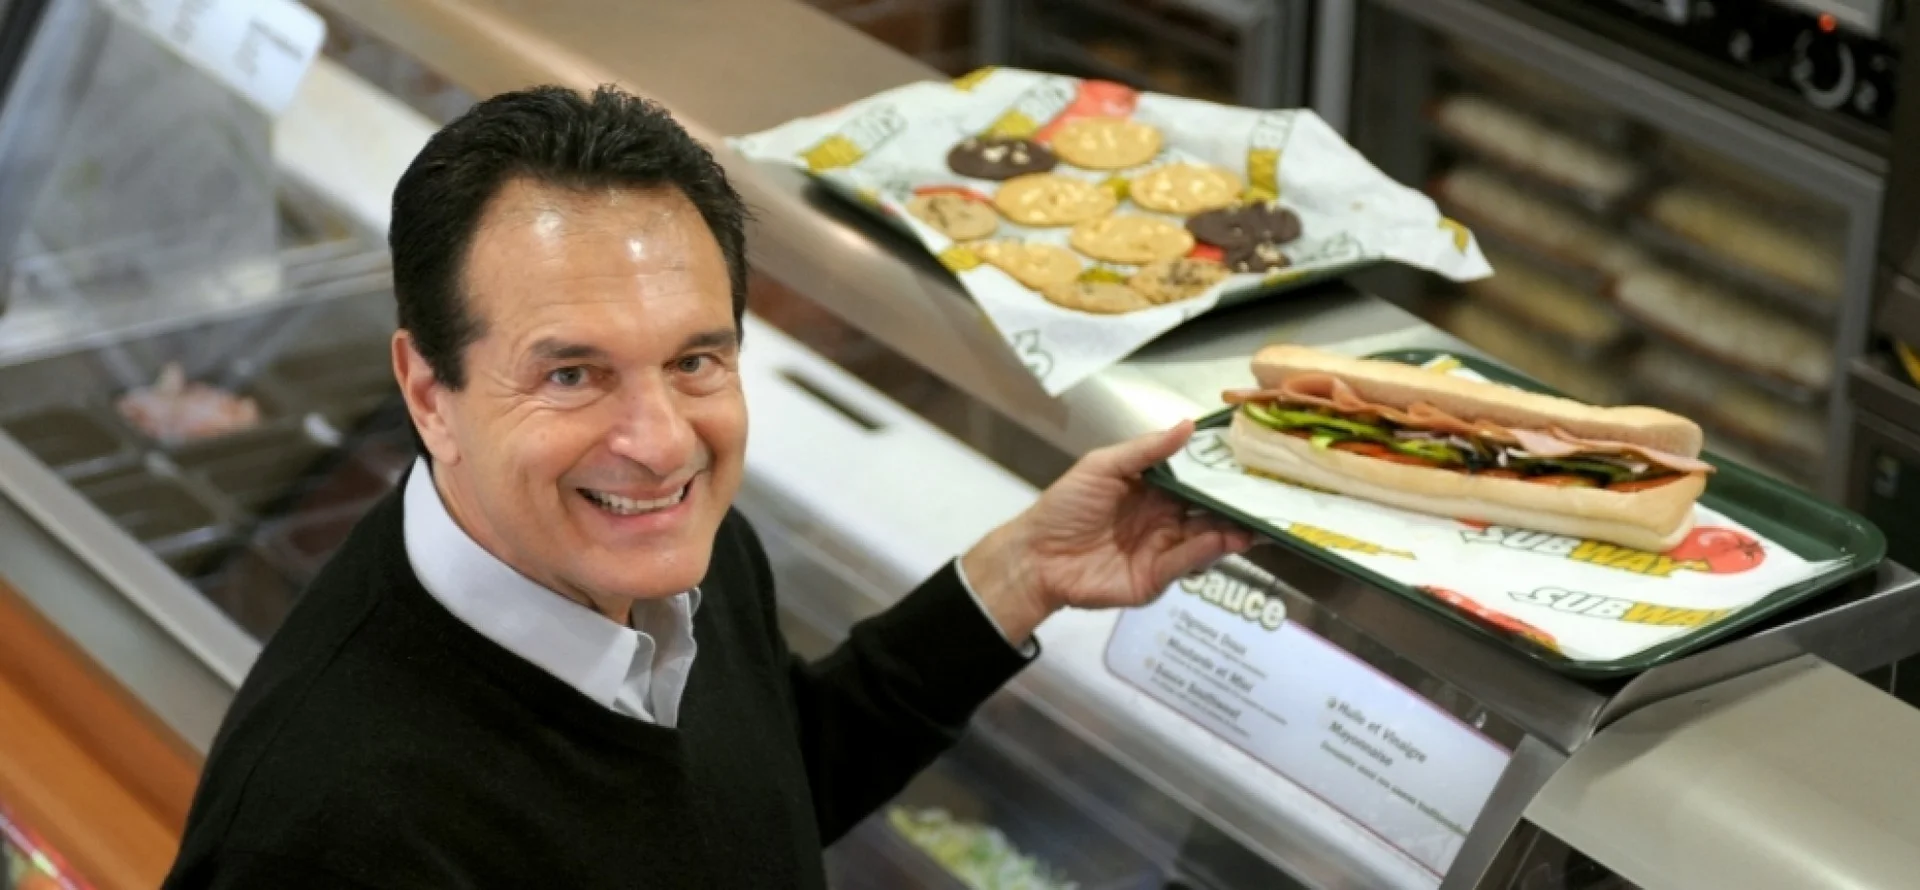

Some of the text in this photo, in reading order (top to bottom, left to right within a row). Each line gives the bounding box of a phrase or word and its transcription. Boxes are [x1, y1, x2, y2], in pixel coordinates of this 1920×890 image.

[1460, 524, 1712, 578] SUBWAY
[1328, 721, 1393, 766] Mayonnaise
[1367, 721, 1381, 734] et
[1383, 728, 1427, 763] Vinaigre
